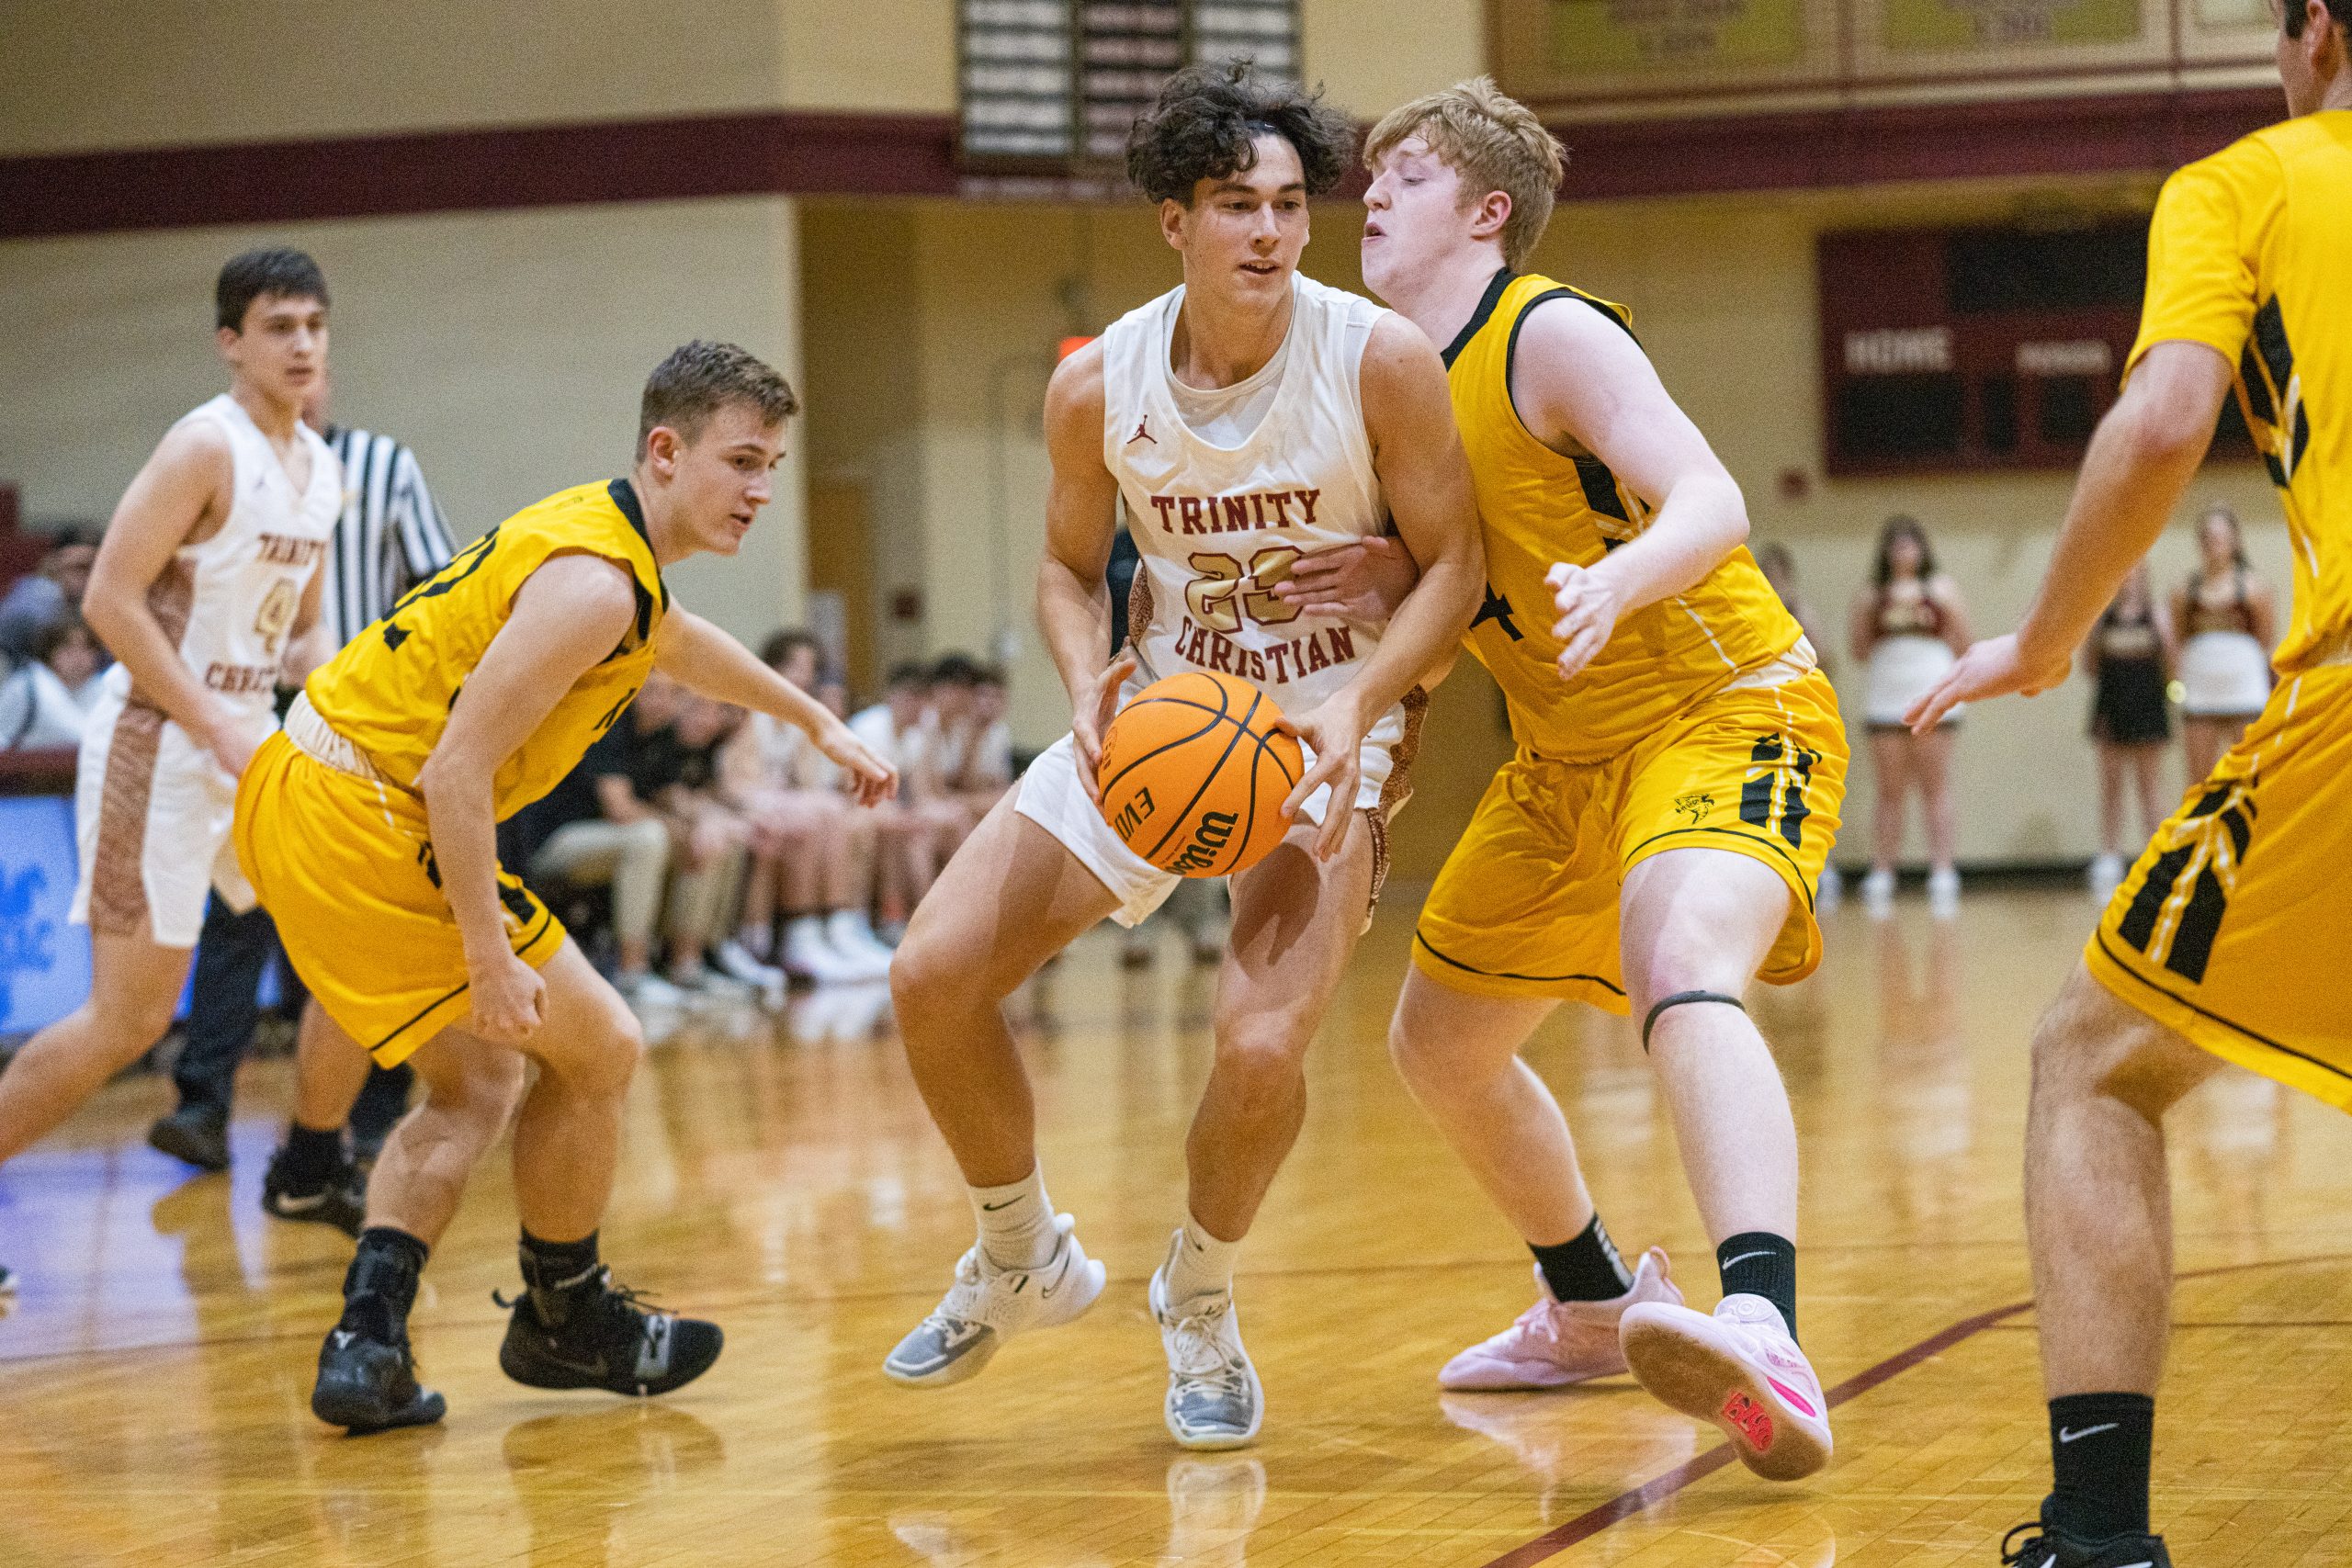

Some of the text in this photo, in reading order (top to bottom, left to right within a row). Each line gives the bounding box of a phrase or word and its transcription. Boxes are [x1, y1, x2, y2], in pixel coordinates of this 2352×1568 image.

[1150, 489, 1321, 535] TRINITY
[253, 577, 300, 657] 4
[1184, 545, 1306, 634] 23
[1174, 615, 1356, 684] CHRISTIAN
[1165, 811, 1239, 875] Wilso
